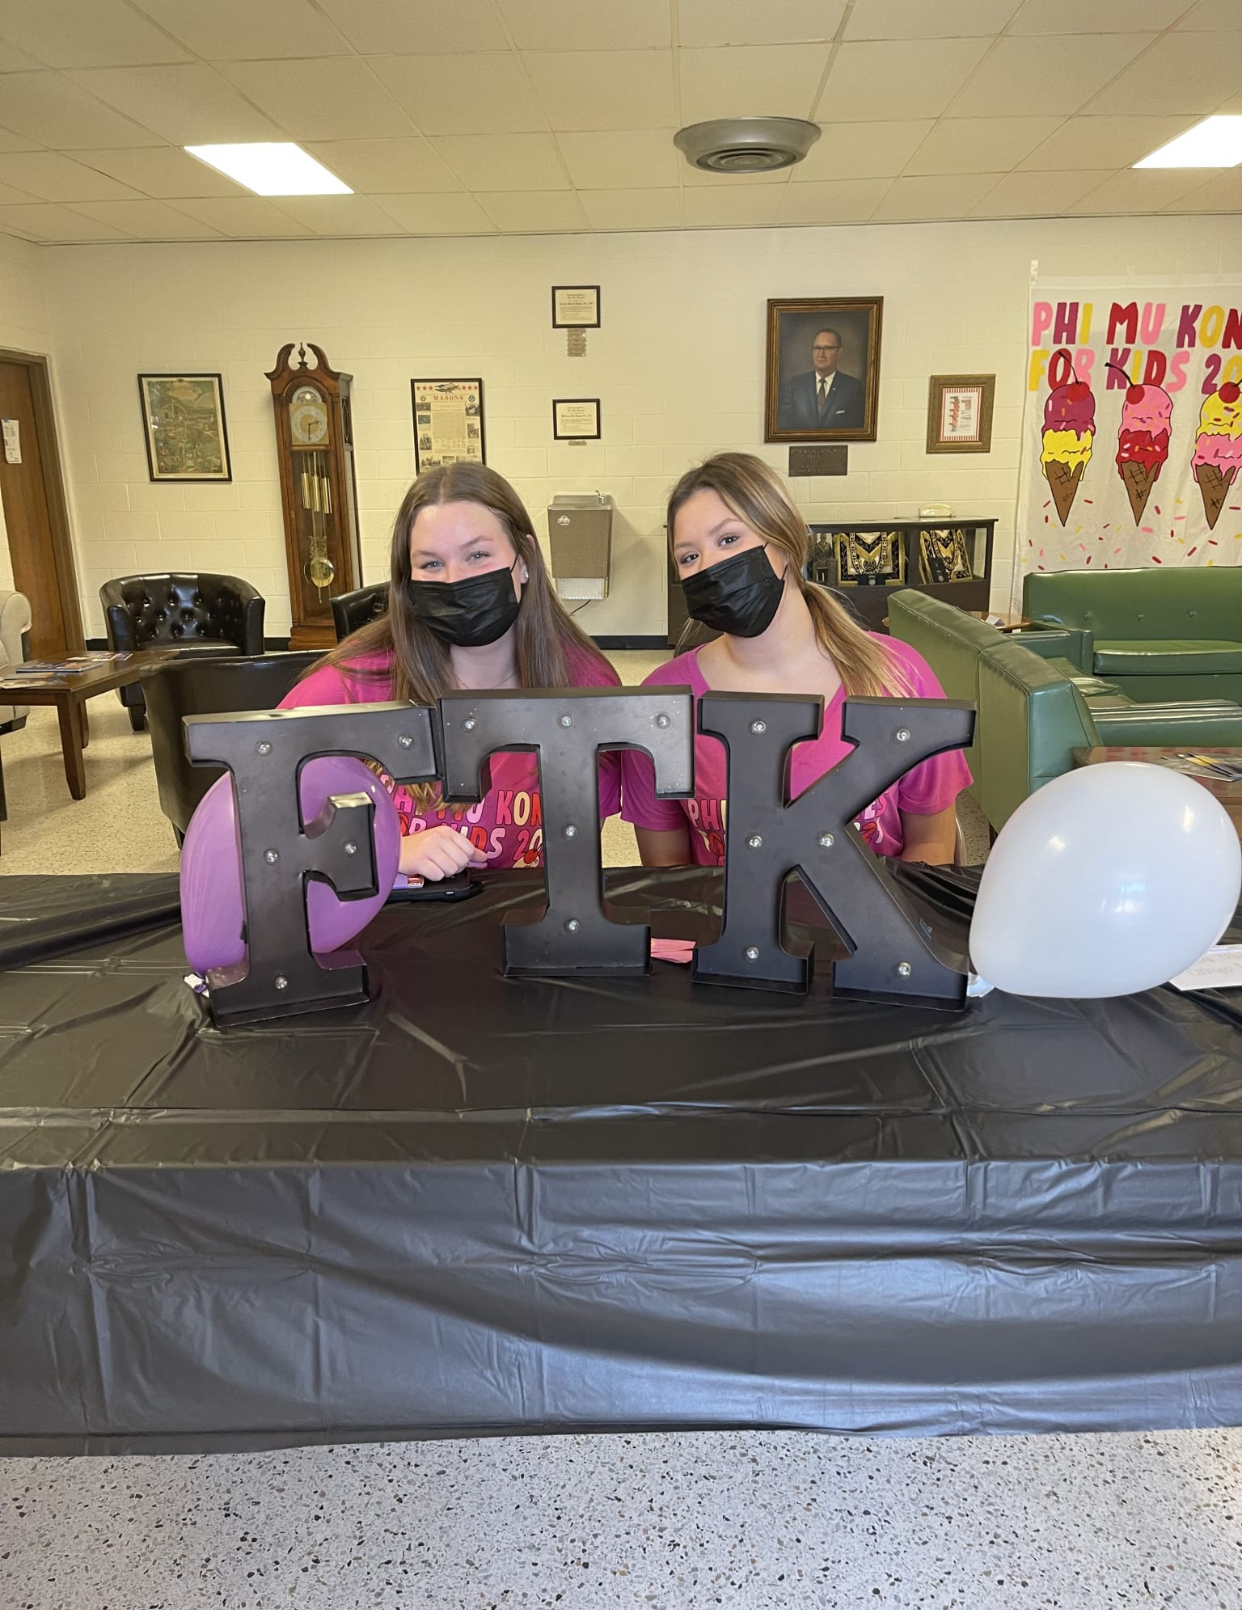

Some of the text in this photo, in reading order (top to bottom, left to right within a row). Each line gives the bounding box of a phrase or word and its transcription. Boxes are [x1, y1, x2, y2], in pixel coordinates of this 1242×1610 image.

[1031, 302, 1093, 346] PHI
[1106, 302, 1166, 345] MU
[1029, 348, 1095, 392] FOR
[1106, 348, 1190, 393] KIDS
